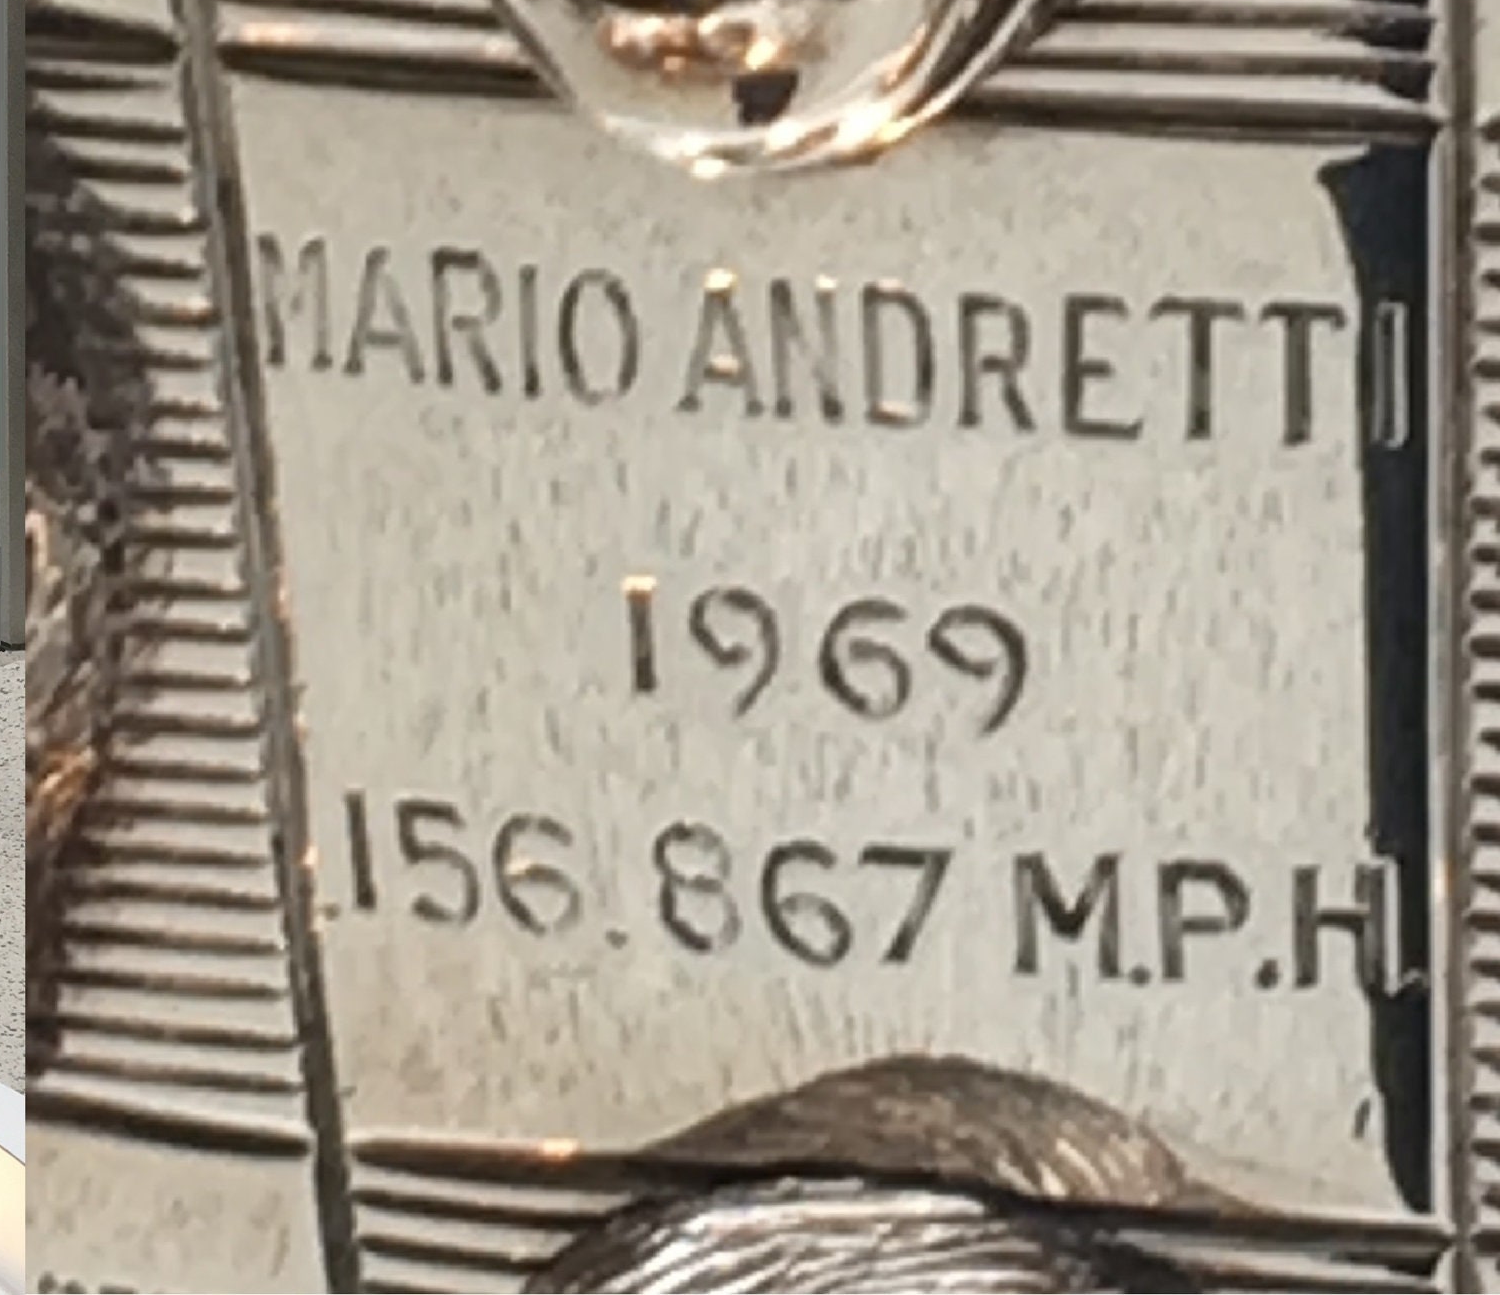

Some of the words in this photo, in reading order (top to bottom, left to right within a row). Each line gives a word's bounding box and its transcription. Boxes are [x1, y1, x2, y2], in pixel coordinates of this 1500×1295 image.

[254, 233, 642, 407] MARIO
[675, 265, 1410, 451] ANDRETTI
[619, 575, 1030, 737] 1969
